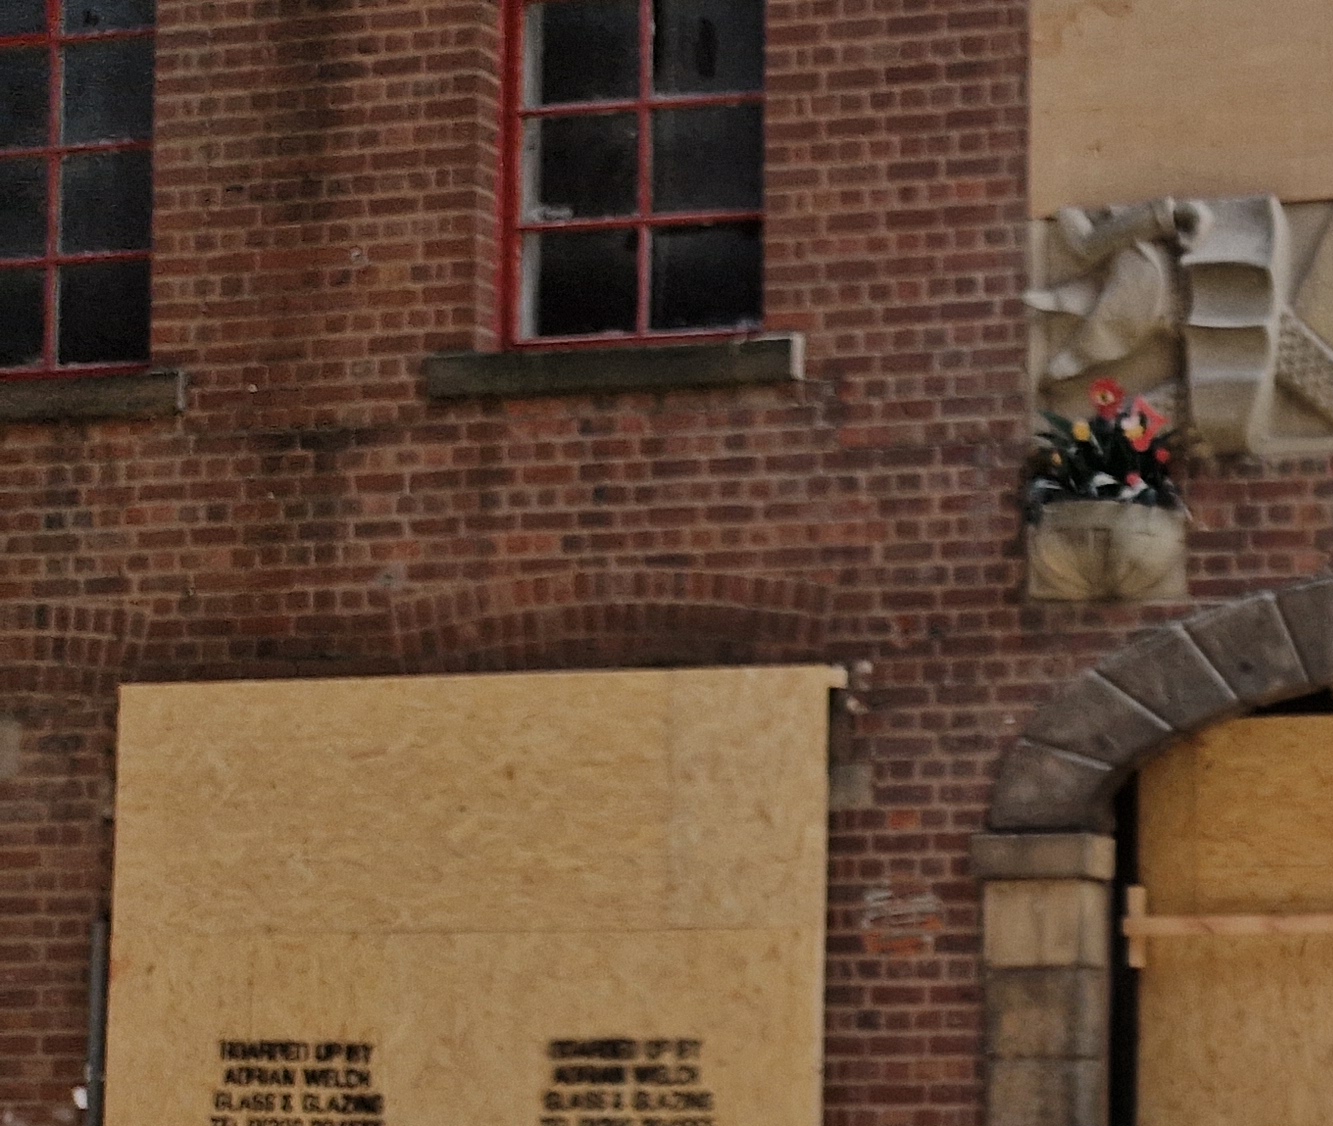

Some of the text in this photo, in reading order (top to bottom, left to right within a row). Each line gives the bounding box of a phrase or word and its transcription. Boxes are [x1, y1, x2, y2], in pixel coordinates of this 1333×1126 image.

[315, 1040, 343, 1062] UP
[224, 1066, 371, 1088] ADRIAN WELCH
[213, 1091, 276, 1113] GLASS
